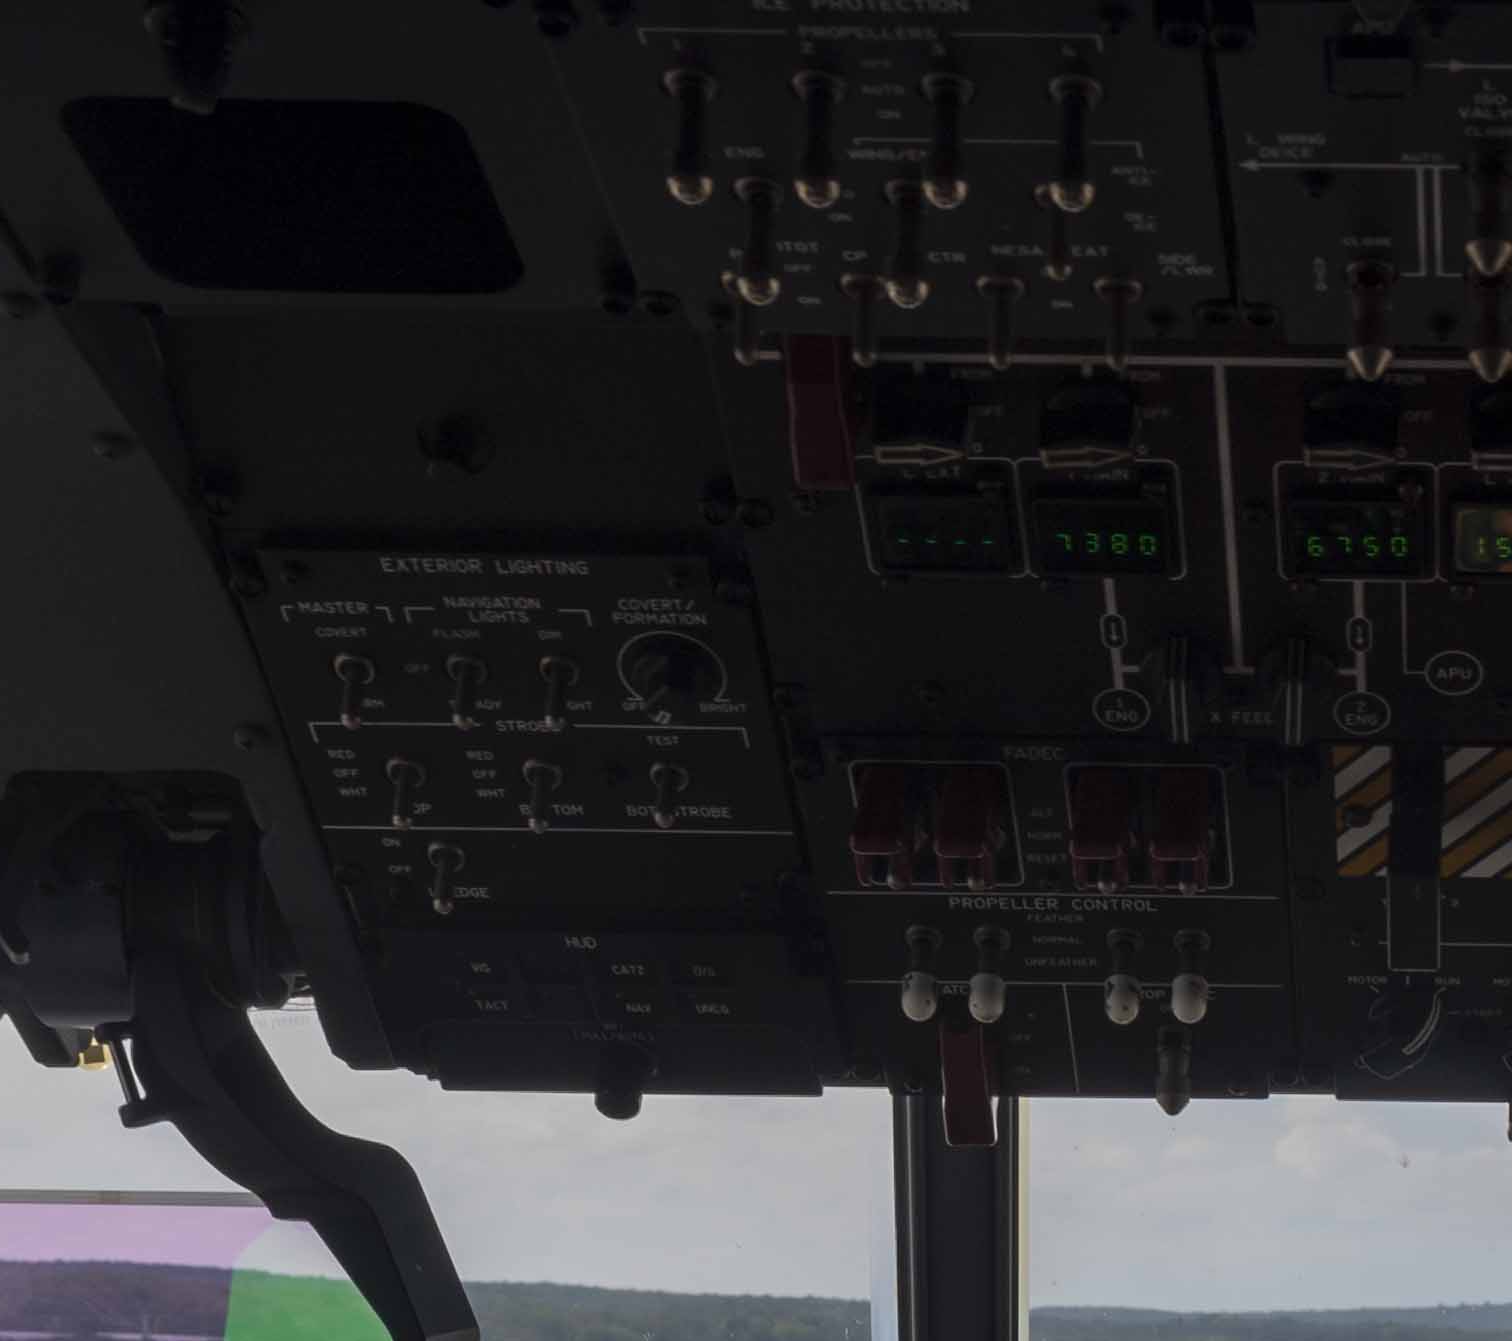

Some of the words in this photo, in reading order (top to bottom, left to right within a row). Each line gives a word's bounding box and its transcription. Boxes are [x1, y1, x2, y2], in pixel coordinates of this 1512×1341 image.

[1055, 533, 1158, 557] 7380
[1307, 535, 1410, 558] 6750
[380, 558, 483, 574] EXTERIOR
[496, 559, 589, 576] LIGHTING
[297, 601, 369, 615] MASTER
[443, 596, 541, 610] NAVIGATION
[468, 610, 529, 625] LIGHTS
[612, 610, 707, 626] FORMATION
[1436, 666, 1472, 681] APU
[1105, 709, 1139, 723] ENG
[1345, 712, 1379, 726] ENG
[648, 734, 679, 746] TEST
[1003, 747, 1063, 761] FADEC
[948, 896, 1059, 911] PROPELLER
[1071, 898, 1158, 912] CONTROL
[564, 936, 596, 949] HUD
